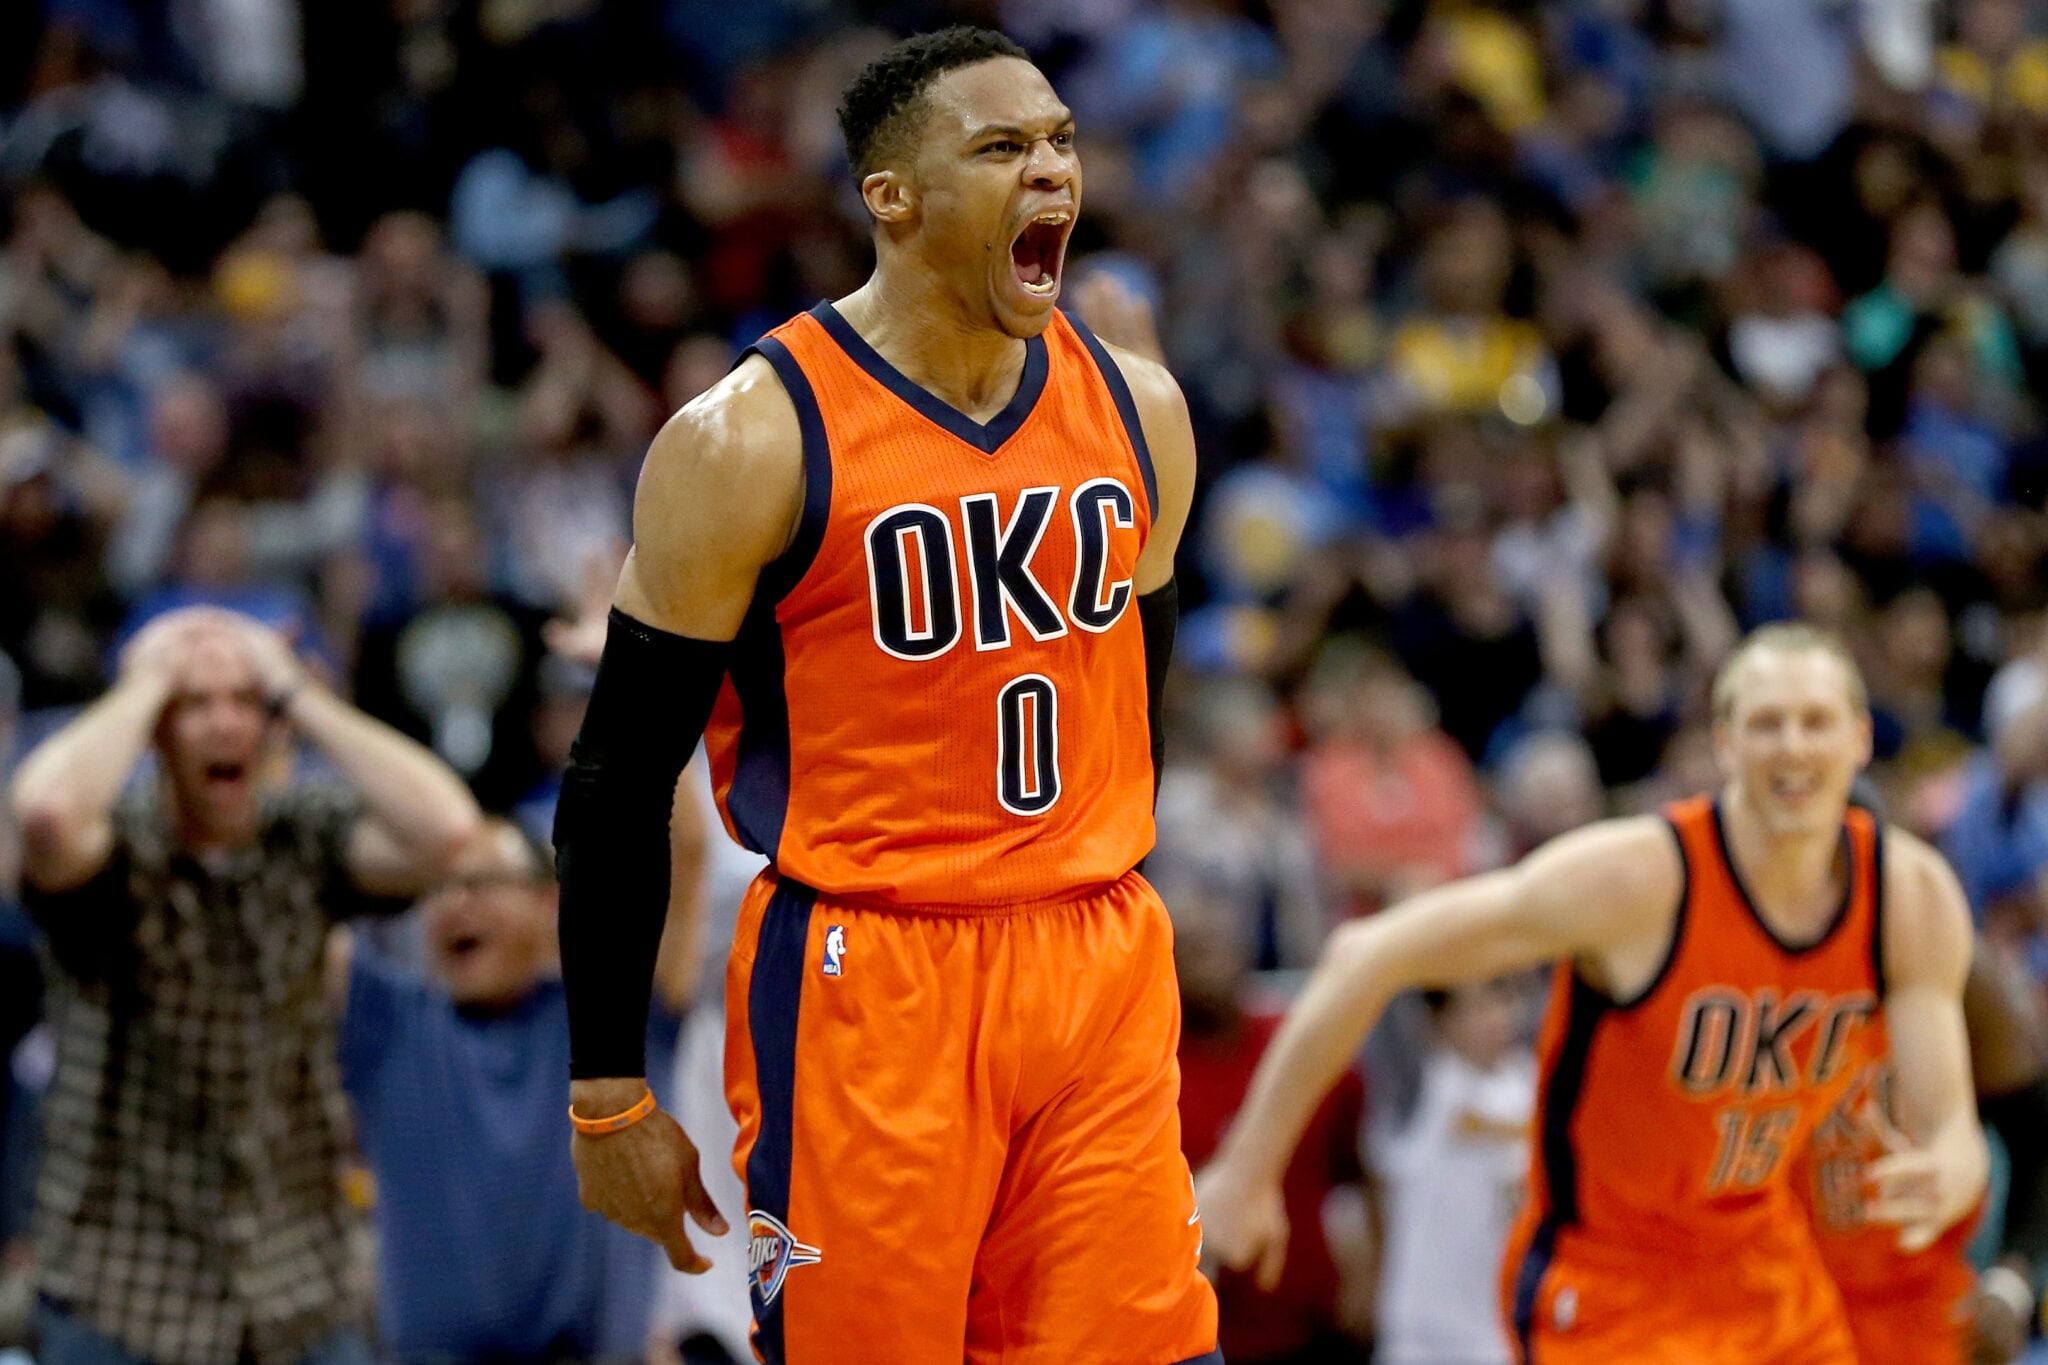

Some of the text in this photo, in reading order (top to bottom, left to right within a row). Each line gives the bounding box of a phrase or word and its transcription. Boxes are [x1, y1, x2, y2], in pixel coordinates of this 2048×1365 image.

[864, 477, 1134, 661] OKC
[997, 673, 1062, 816] 0
[1672, 985, 1878, 1096] OKC
[1709, 1106, 1799, 1192] 15
[750, 1236, 779, 1273] OKC
